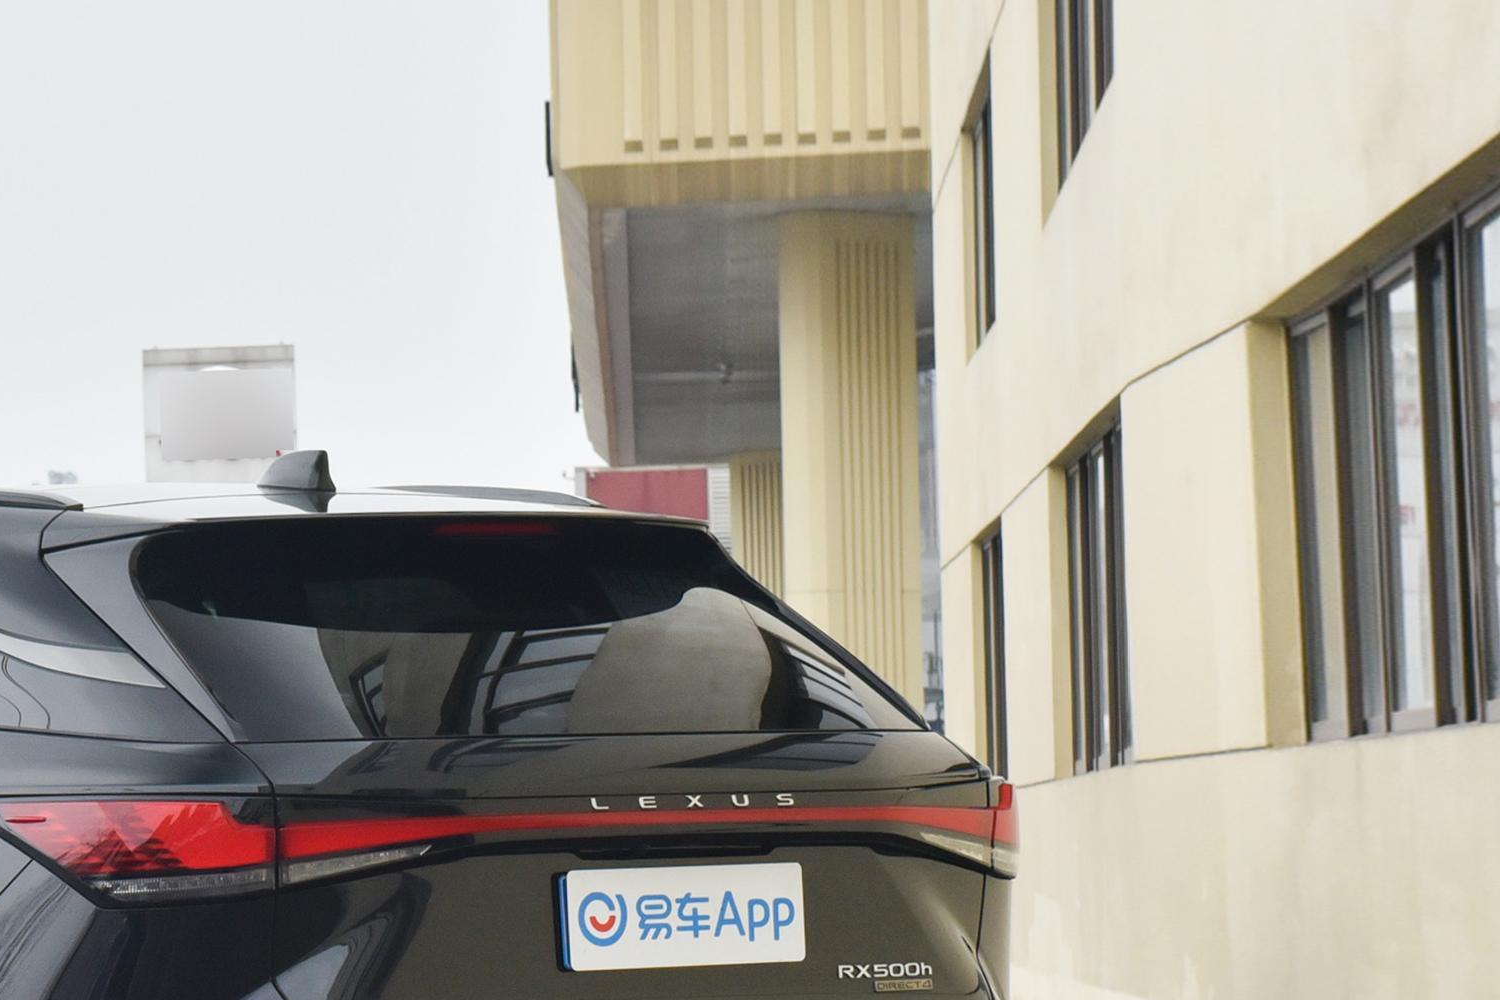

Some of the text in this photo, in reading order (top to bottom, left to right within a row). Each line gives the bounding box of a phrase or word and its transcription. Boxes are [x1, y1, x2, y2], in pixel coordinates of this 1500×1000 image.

[590, 793, 795, 810] LEXUS
[636, 890, 796, 942] 易车App
[837, 962, 933, 979] RX500h
